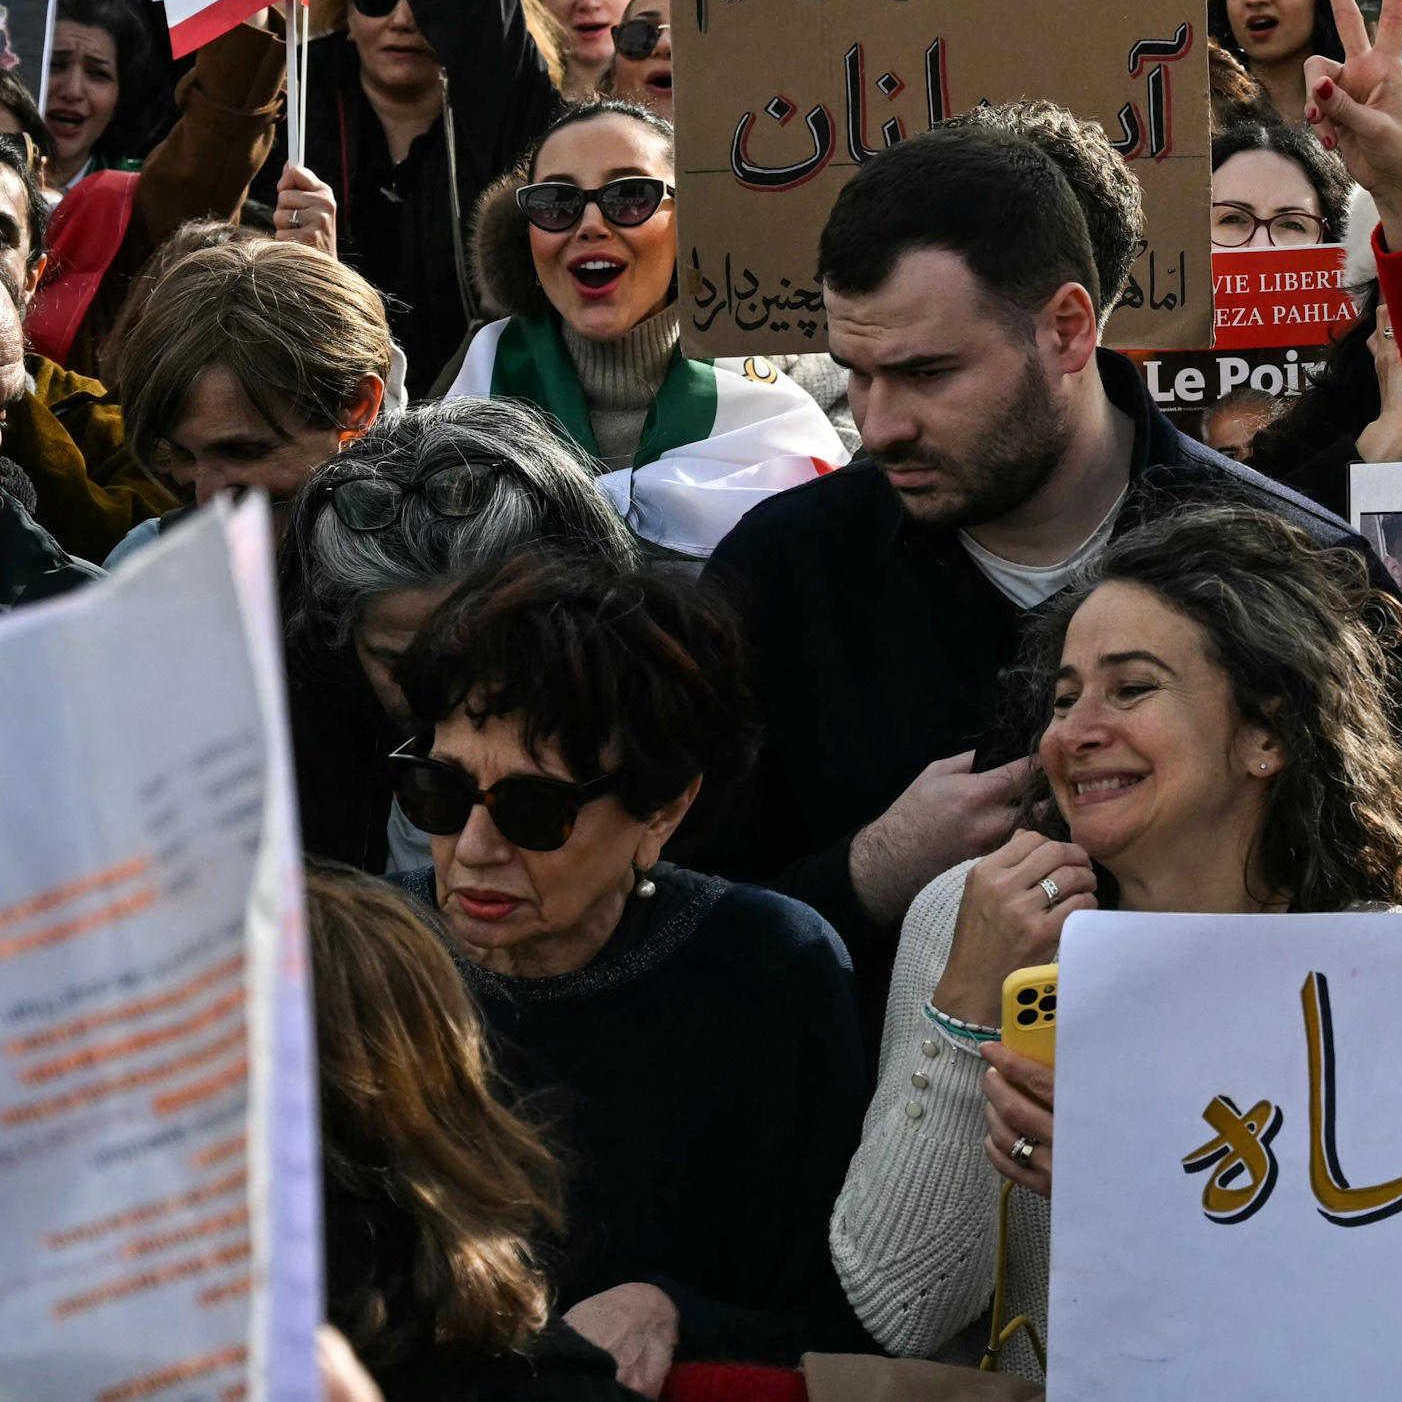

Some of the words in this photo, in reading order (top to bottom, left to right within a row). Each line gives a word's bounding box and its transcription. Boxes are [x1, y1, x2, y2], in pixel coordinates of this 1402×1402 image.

[1259, 269, 1347, 294] LIBERT
[1212, 305, 1265, 329] EZA
[1272, 299, 1364, 325] PAHLAV
[1143, 360, 1206, 403] Le
